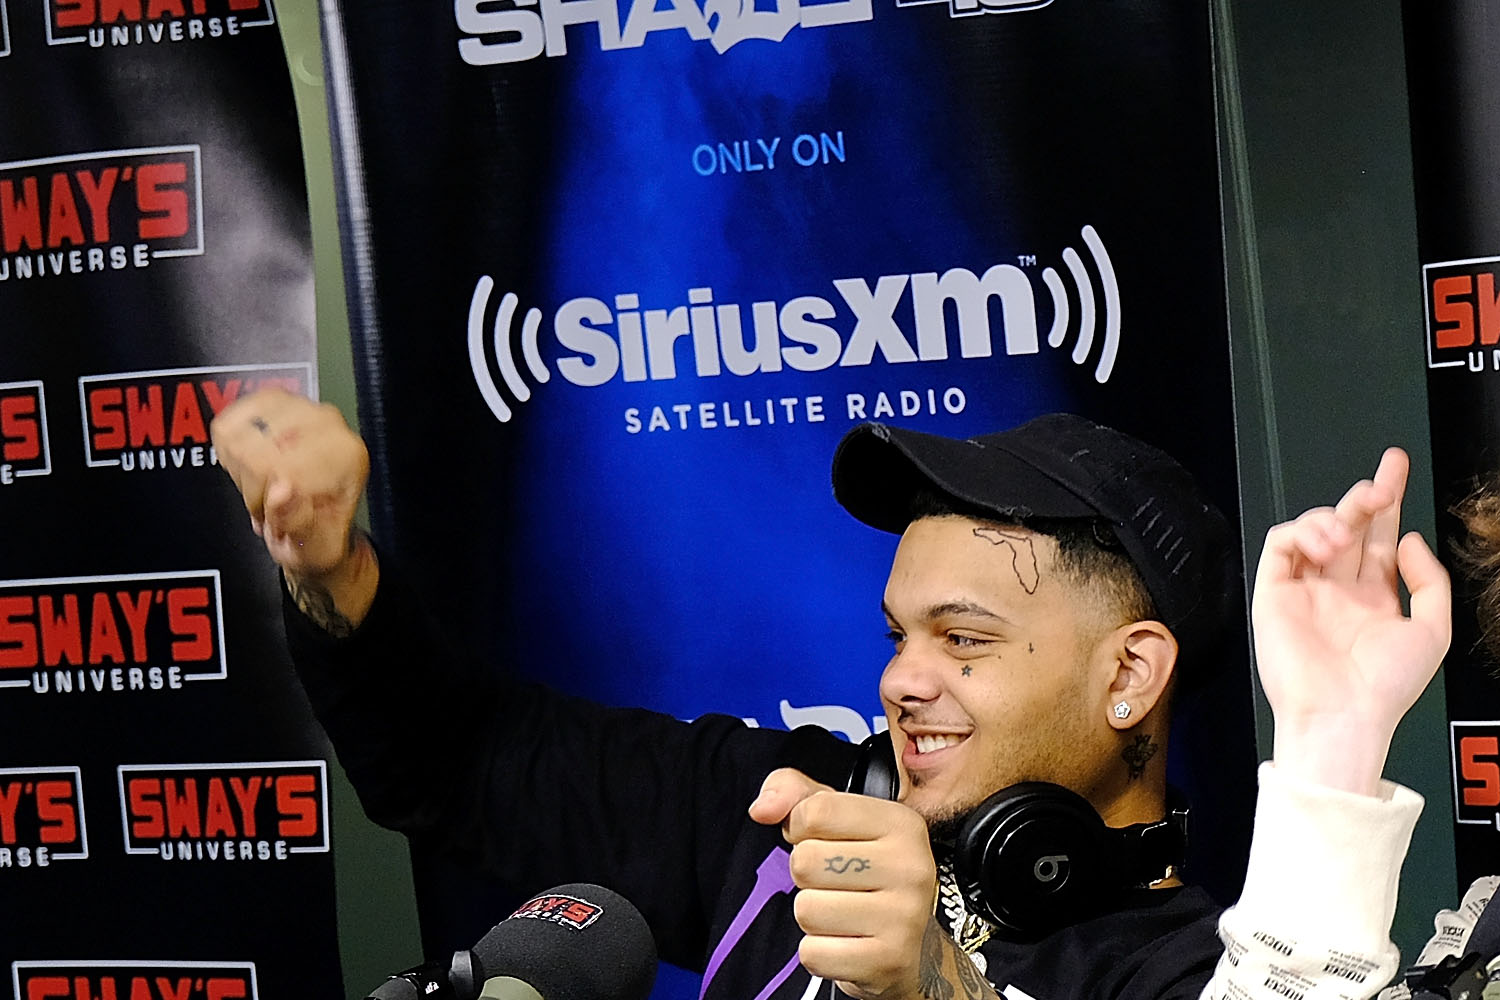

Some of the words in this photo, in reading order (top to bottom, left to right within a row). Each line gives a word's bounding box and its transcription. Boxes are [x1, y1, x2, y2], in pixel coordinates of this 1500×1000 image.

[89, 17, 240, 47] UNIVERSE
[693, 137, 781, 176] ONLY
[791, 132, 846, 167] ON
[0, 162, 190, 252] WAY'S
[624, 396, 826, 434] SATELLITE
[846, 387, 967, 420] RADIO
[121, 446, 218, 471] UNIVE
[0, 587, 214, 669] SWAY'S
[33, 666, 182, 693] UNIVERSE
[129, 774, 318, 839] SWAY'S
[160, 840, 288, 861] UNIVERSE
